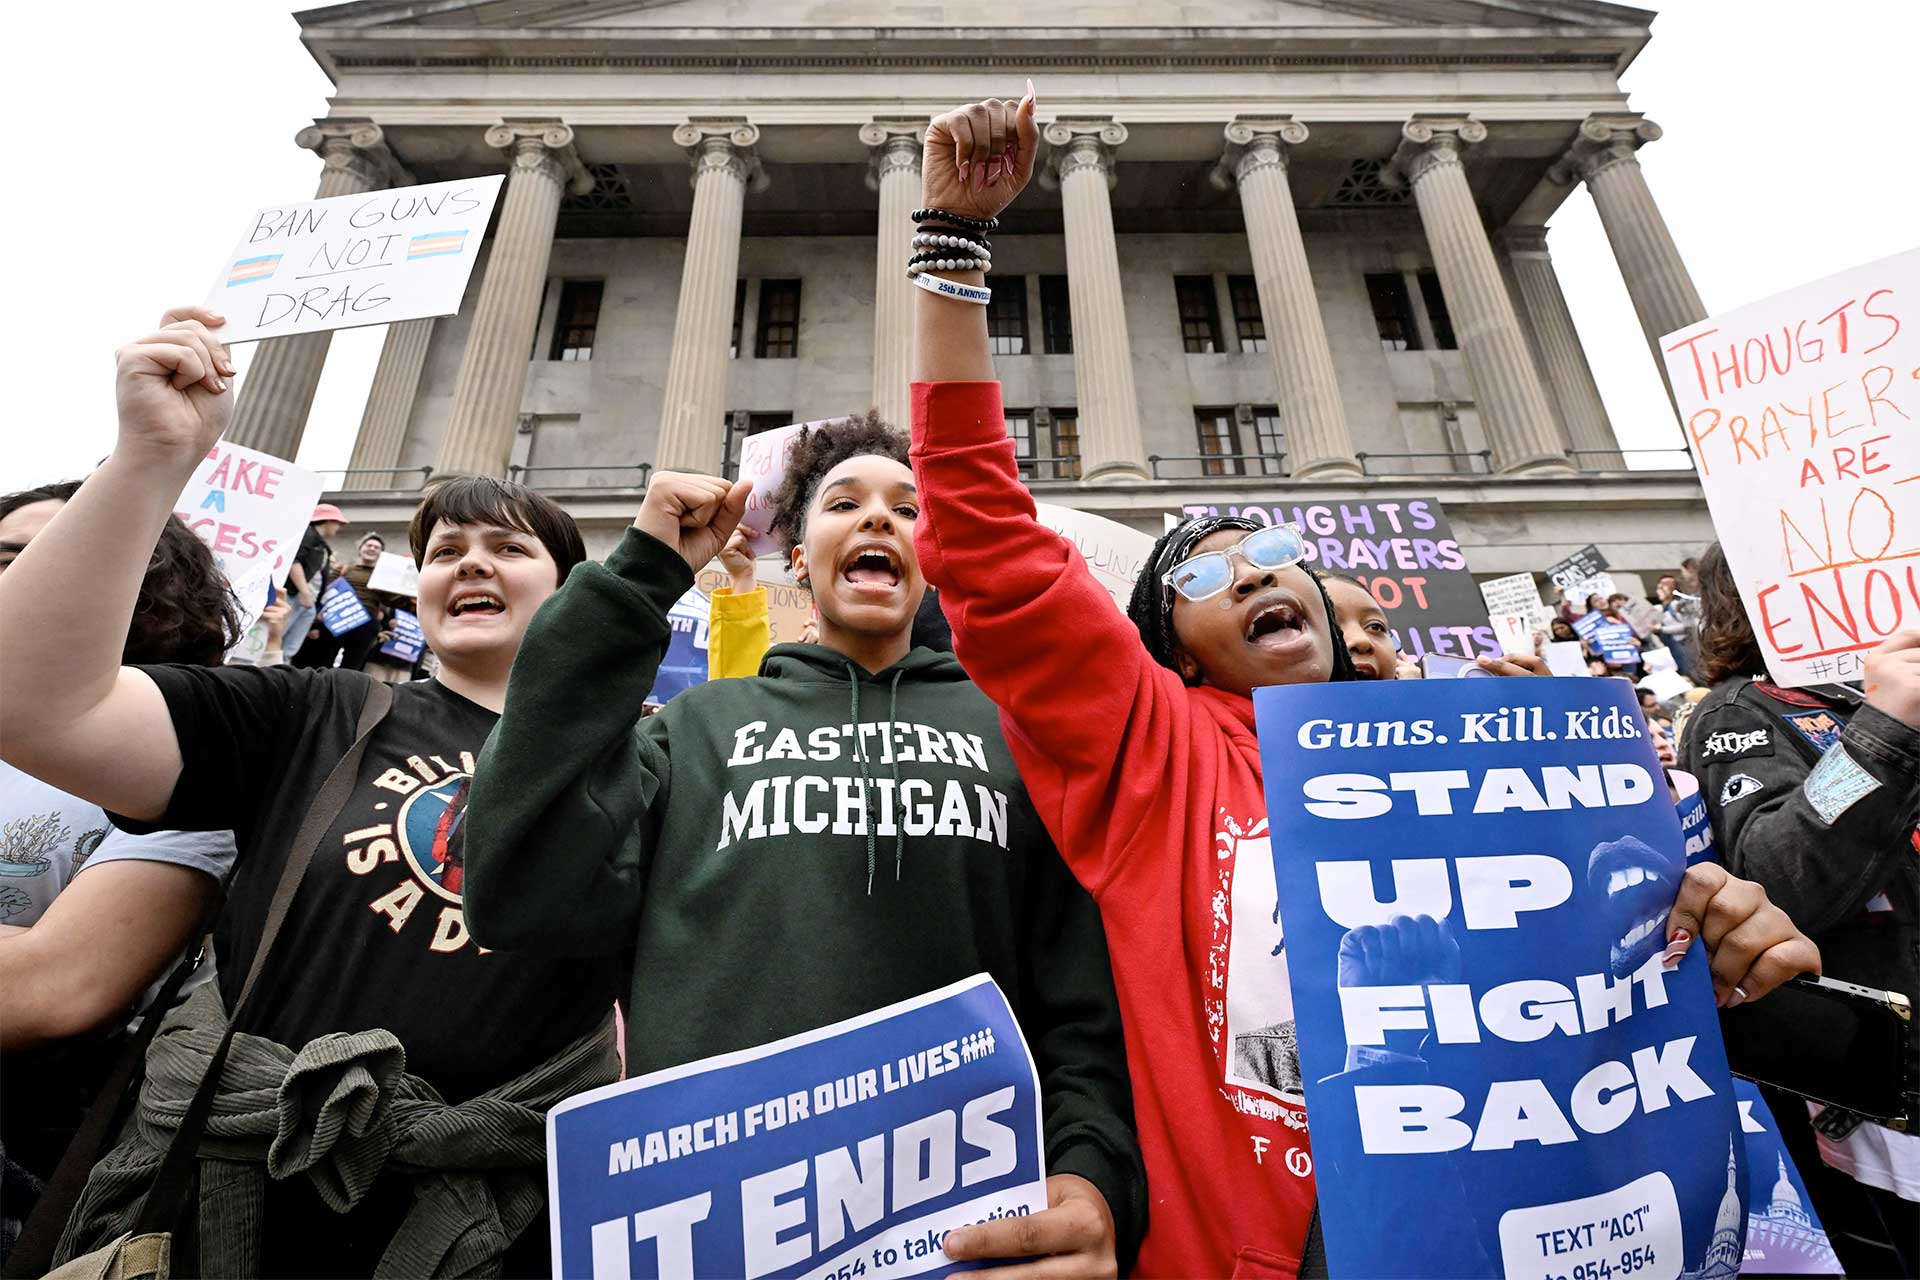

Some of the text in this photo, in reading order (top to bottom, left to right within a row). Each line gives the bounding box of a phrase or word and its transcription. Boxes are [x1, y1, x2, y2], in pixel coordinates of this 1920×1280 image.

[249, 188, 480, 243] BAN GUNS
[309, 234, 401, 270] NOT
[256, 283, 391, 327] DRAG
[938, 282, 956, 294] 25th
[1667, 290, 1899, 399] THOUGTS
[1801, 436, 1891, 487] ARE
[200, 490, 225, 513] A
[1358, 575, 1428, 609] OT
[727, 720, 990, 773] EASTERN
[1298, 705, 1641, 750] Guns. Kill. Kids.
[716, 775, 1010, 852] MICHIGAN
[1302, 763, 1654, 820] STAND
[368, 878, 425, 934] A
[1315, 854, 1573, 930] UP
[1337, 951, 1680, 1046] FIGHT
[609, 1039, 960, 1175] MARCH FOR OUR LIVES
[1354, 1035, 1716, 1154] BACK
[591, 1086, 1017, 1280] IT ENDS
[872, 1247, 898, 1268] to
[1536, 1223, 1595, 1257] TEXT
[1573, 1244, 1655, 1280] 954-954
